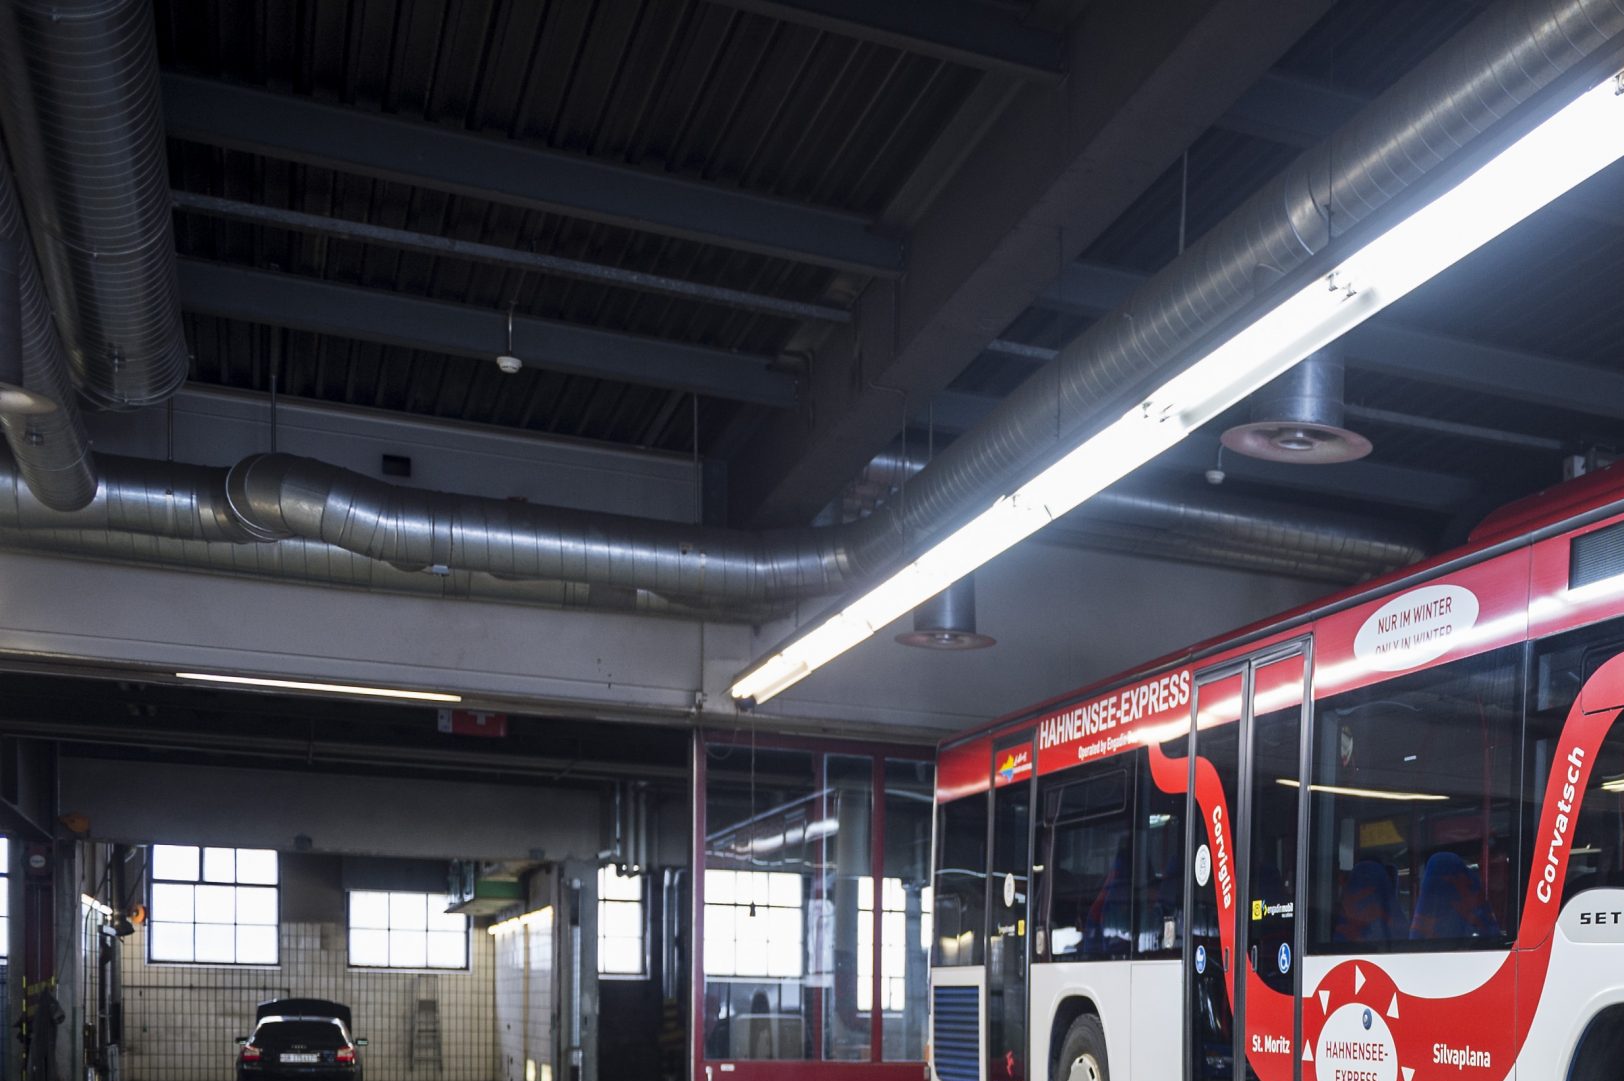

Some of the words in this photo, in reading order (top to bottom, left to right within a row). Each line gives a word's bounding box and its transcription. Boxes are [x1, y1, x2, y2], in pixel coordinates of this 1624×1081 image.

[1378, 614, 1398, 635] NUR
[1400, 609, 1411, 628] IM
[1413, 596, 1452, 623] WINTER
[1039, 670, 1190, 750] HAHNENSEE-EXPRESS
[1078, 740, 1100, 760] Operated
[1536, 747, 1585, 904] Corvatsch
[1213, 805, 1232, 909] Corviglia
[1252, 1034, 1263, 1053] St.
[1264, 1035, 1290, 1054] Moritz
[1325, 1041, 1388, 1062] HAHNENSEE-
[1432, 1043, 1491, 1070] Silvaplana
